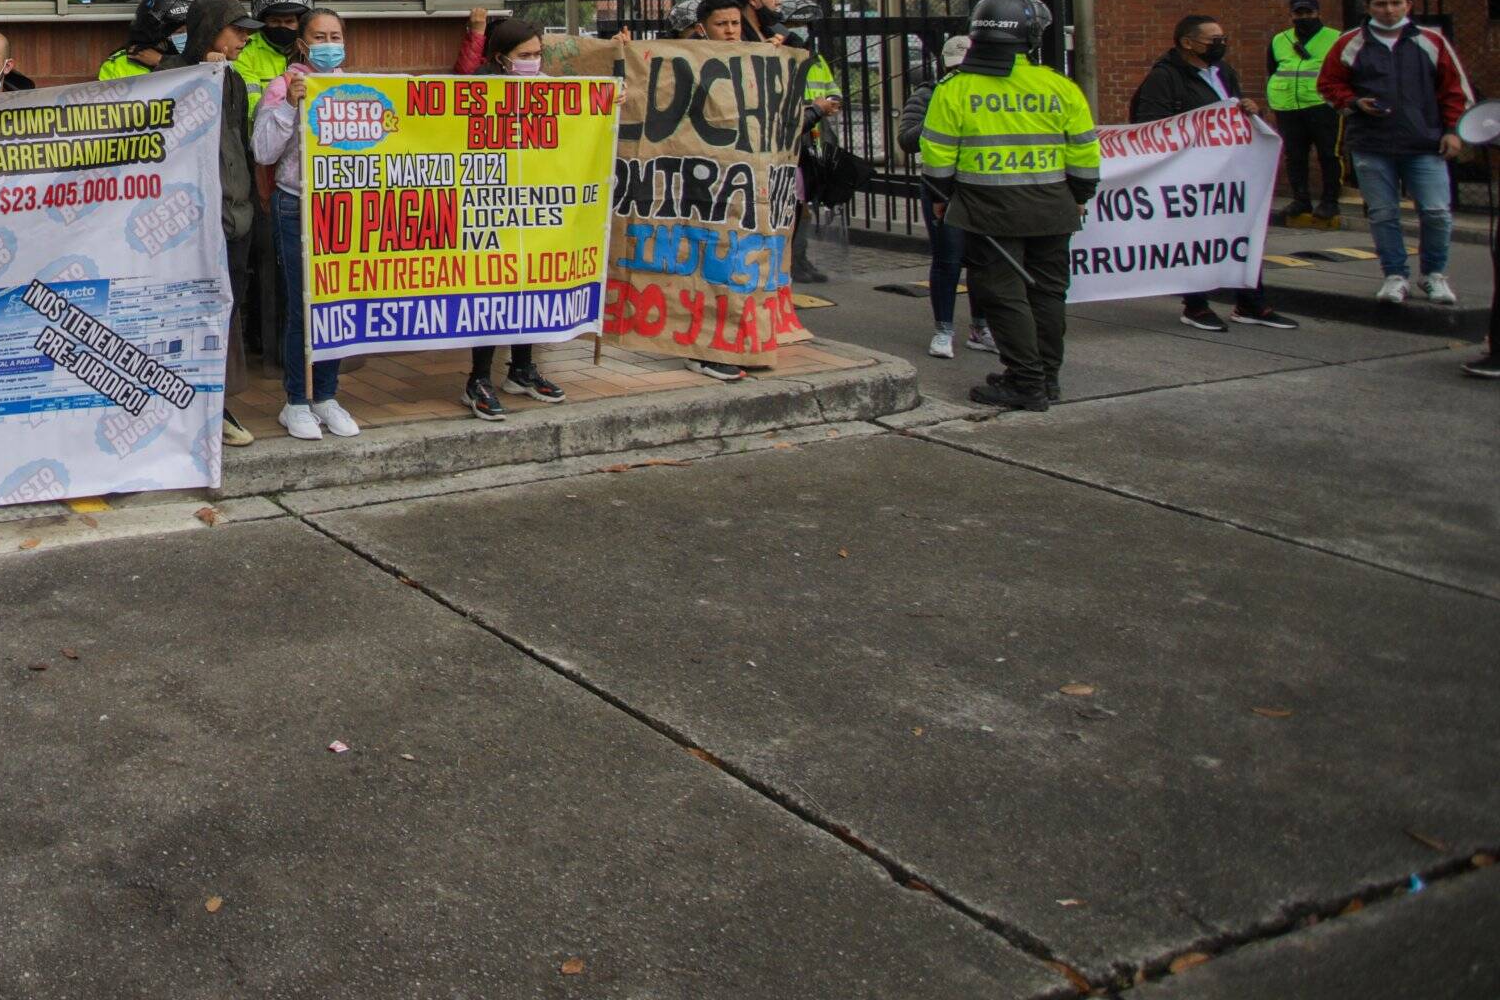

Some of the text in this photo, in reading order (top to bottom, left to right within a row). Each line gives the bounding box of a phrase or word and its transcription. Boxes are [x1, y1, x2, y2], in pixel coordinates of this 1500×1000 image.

[150, 99, 173, 125] DE
[407, 81, 615, 116] NO ES JUSTO NI
[969, 93, 1062, 113] POLICIA
[467, 116, 558, 149] BUENO
[313, 153, 507, 189] DESDE MARZO 2021
[974, 148, 1057, 171] 124451
[0, 174, 161, 215] $23.405.000.000
[462, 184, 599, 207] ARRIENDO DE
[1097, 181, 1246, 222] NOS ESTAN
[312, 188, 457, 255] NO PAGAN
[462, 206, 563, 228] LOCALES
[462, 231, 500, 251] IVA
[314, 246, 598, 296] NO ENTREGAN LOS LOCALES
[312, 286, 591, 345] NOS ESTAN ARRUINANDO
[35, 327, 150, 417] PRE-JURIDICO!
[61, 304, 122, 360] TIENEN
[115, 341, 145, 377] EN
[137, 358, 196, 409] COBRO
